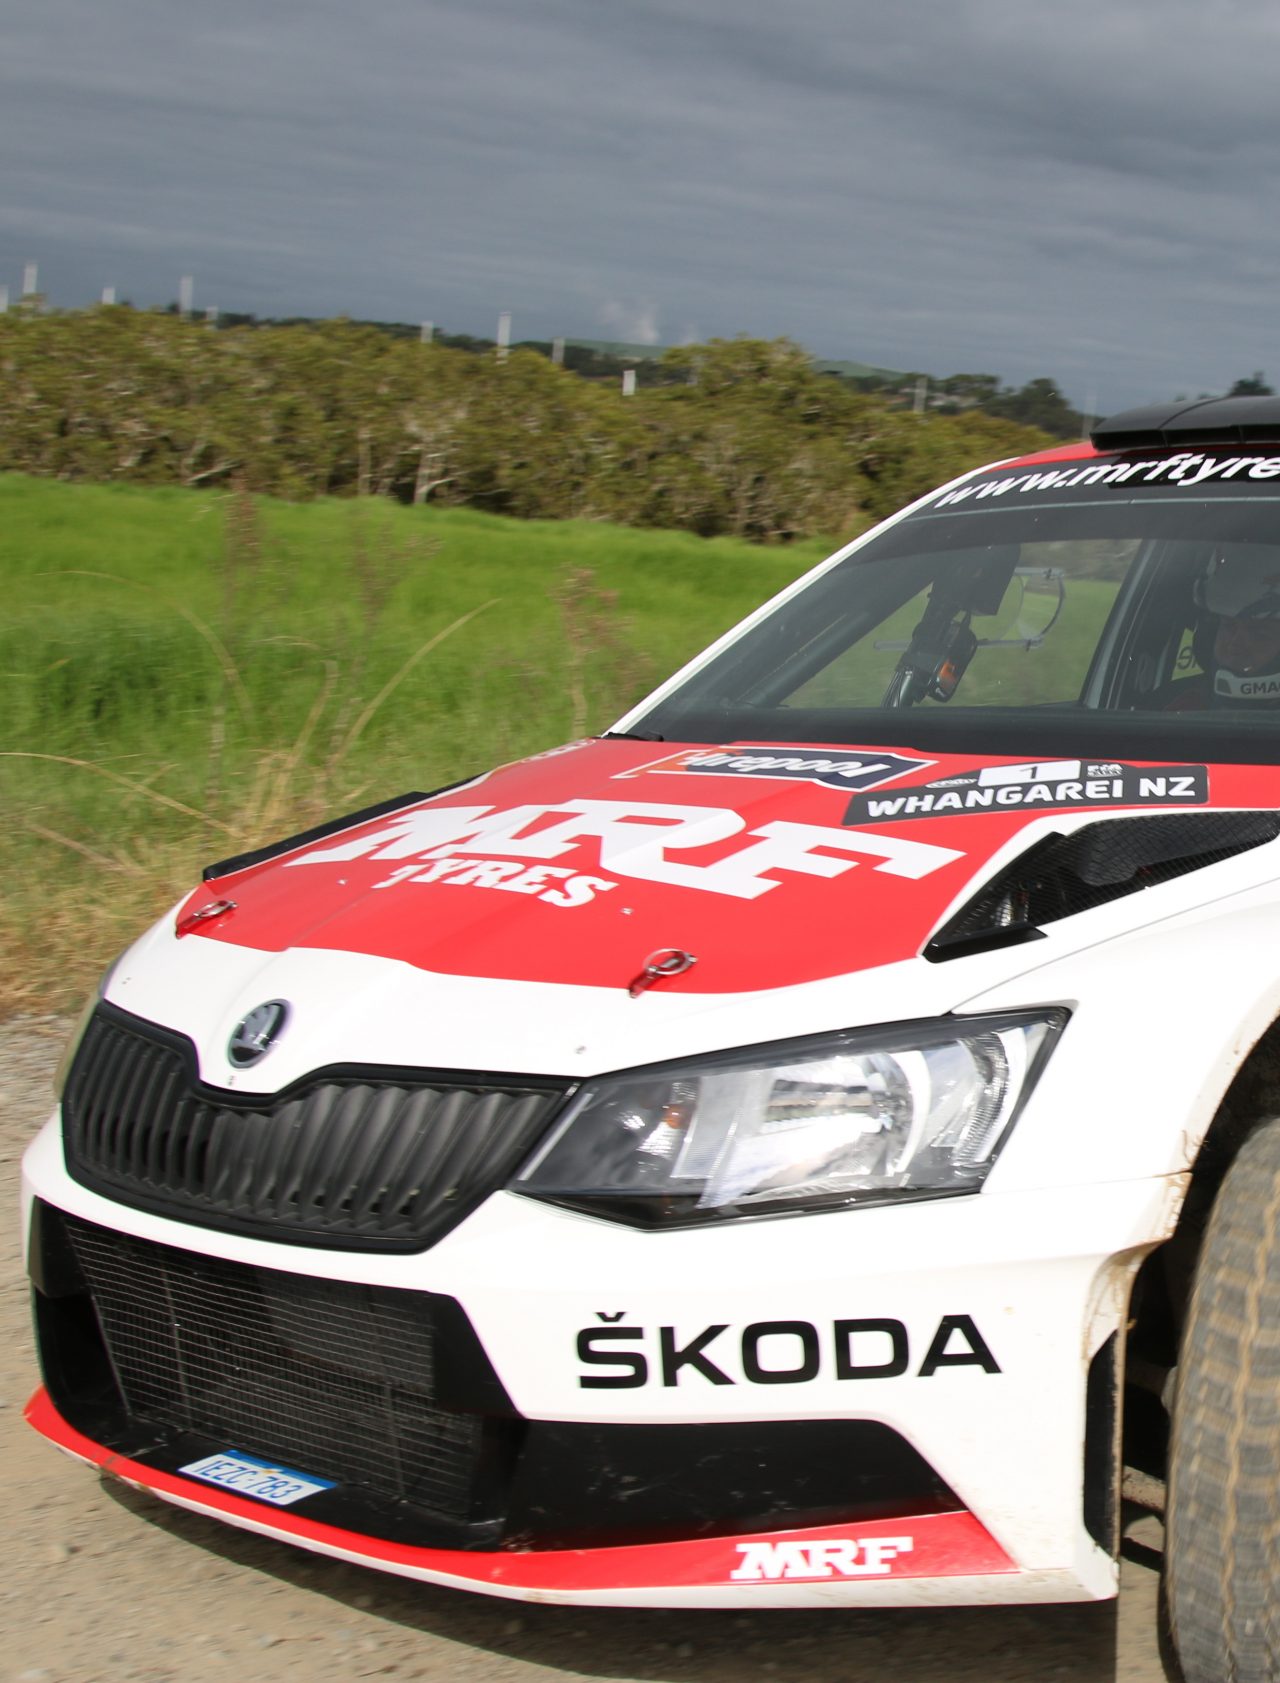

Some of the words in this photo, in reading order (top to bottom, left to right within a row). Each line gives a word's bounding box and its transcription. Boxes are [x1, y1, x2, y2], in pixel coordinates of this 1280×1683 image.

[1020, 765, 1038, 780] 1
[867, 779, 1123, 818] WHANGAREI
[1138, 776, 1196, 798] NZ
[283, 798, 967, 900] MRF
[371, 858, 619, 908] TYRES
[576, 1311, 1003, 1389] ŠKODA
[730, 1536, 913, 1580] MRF
